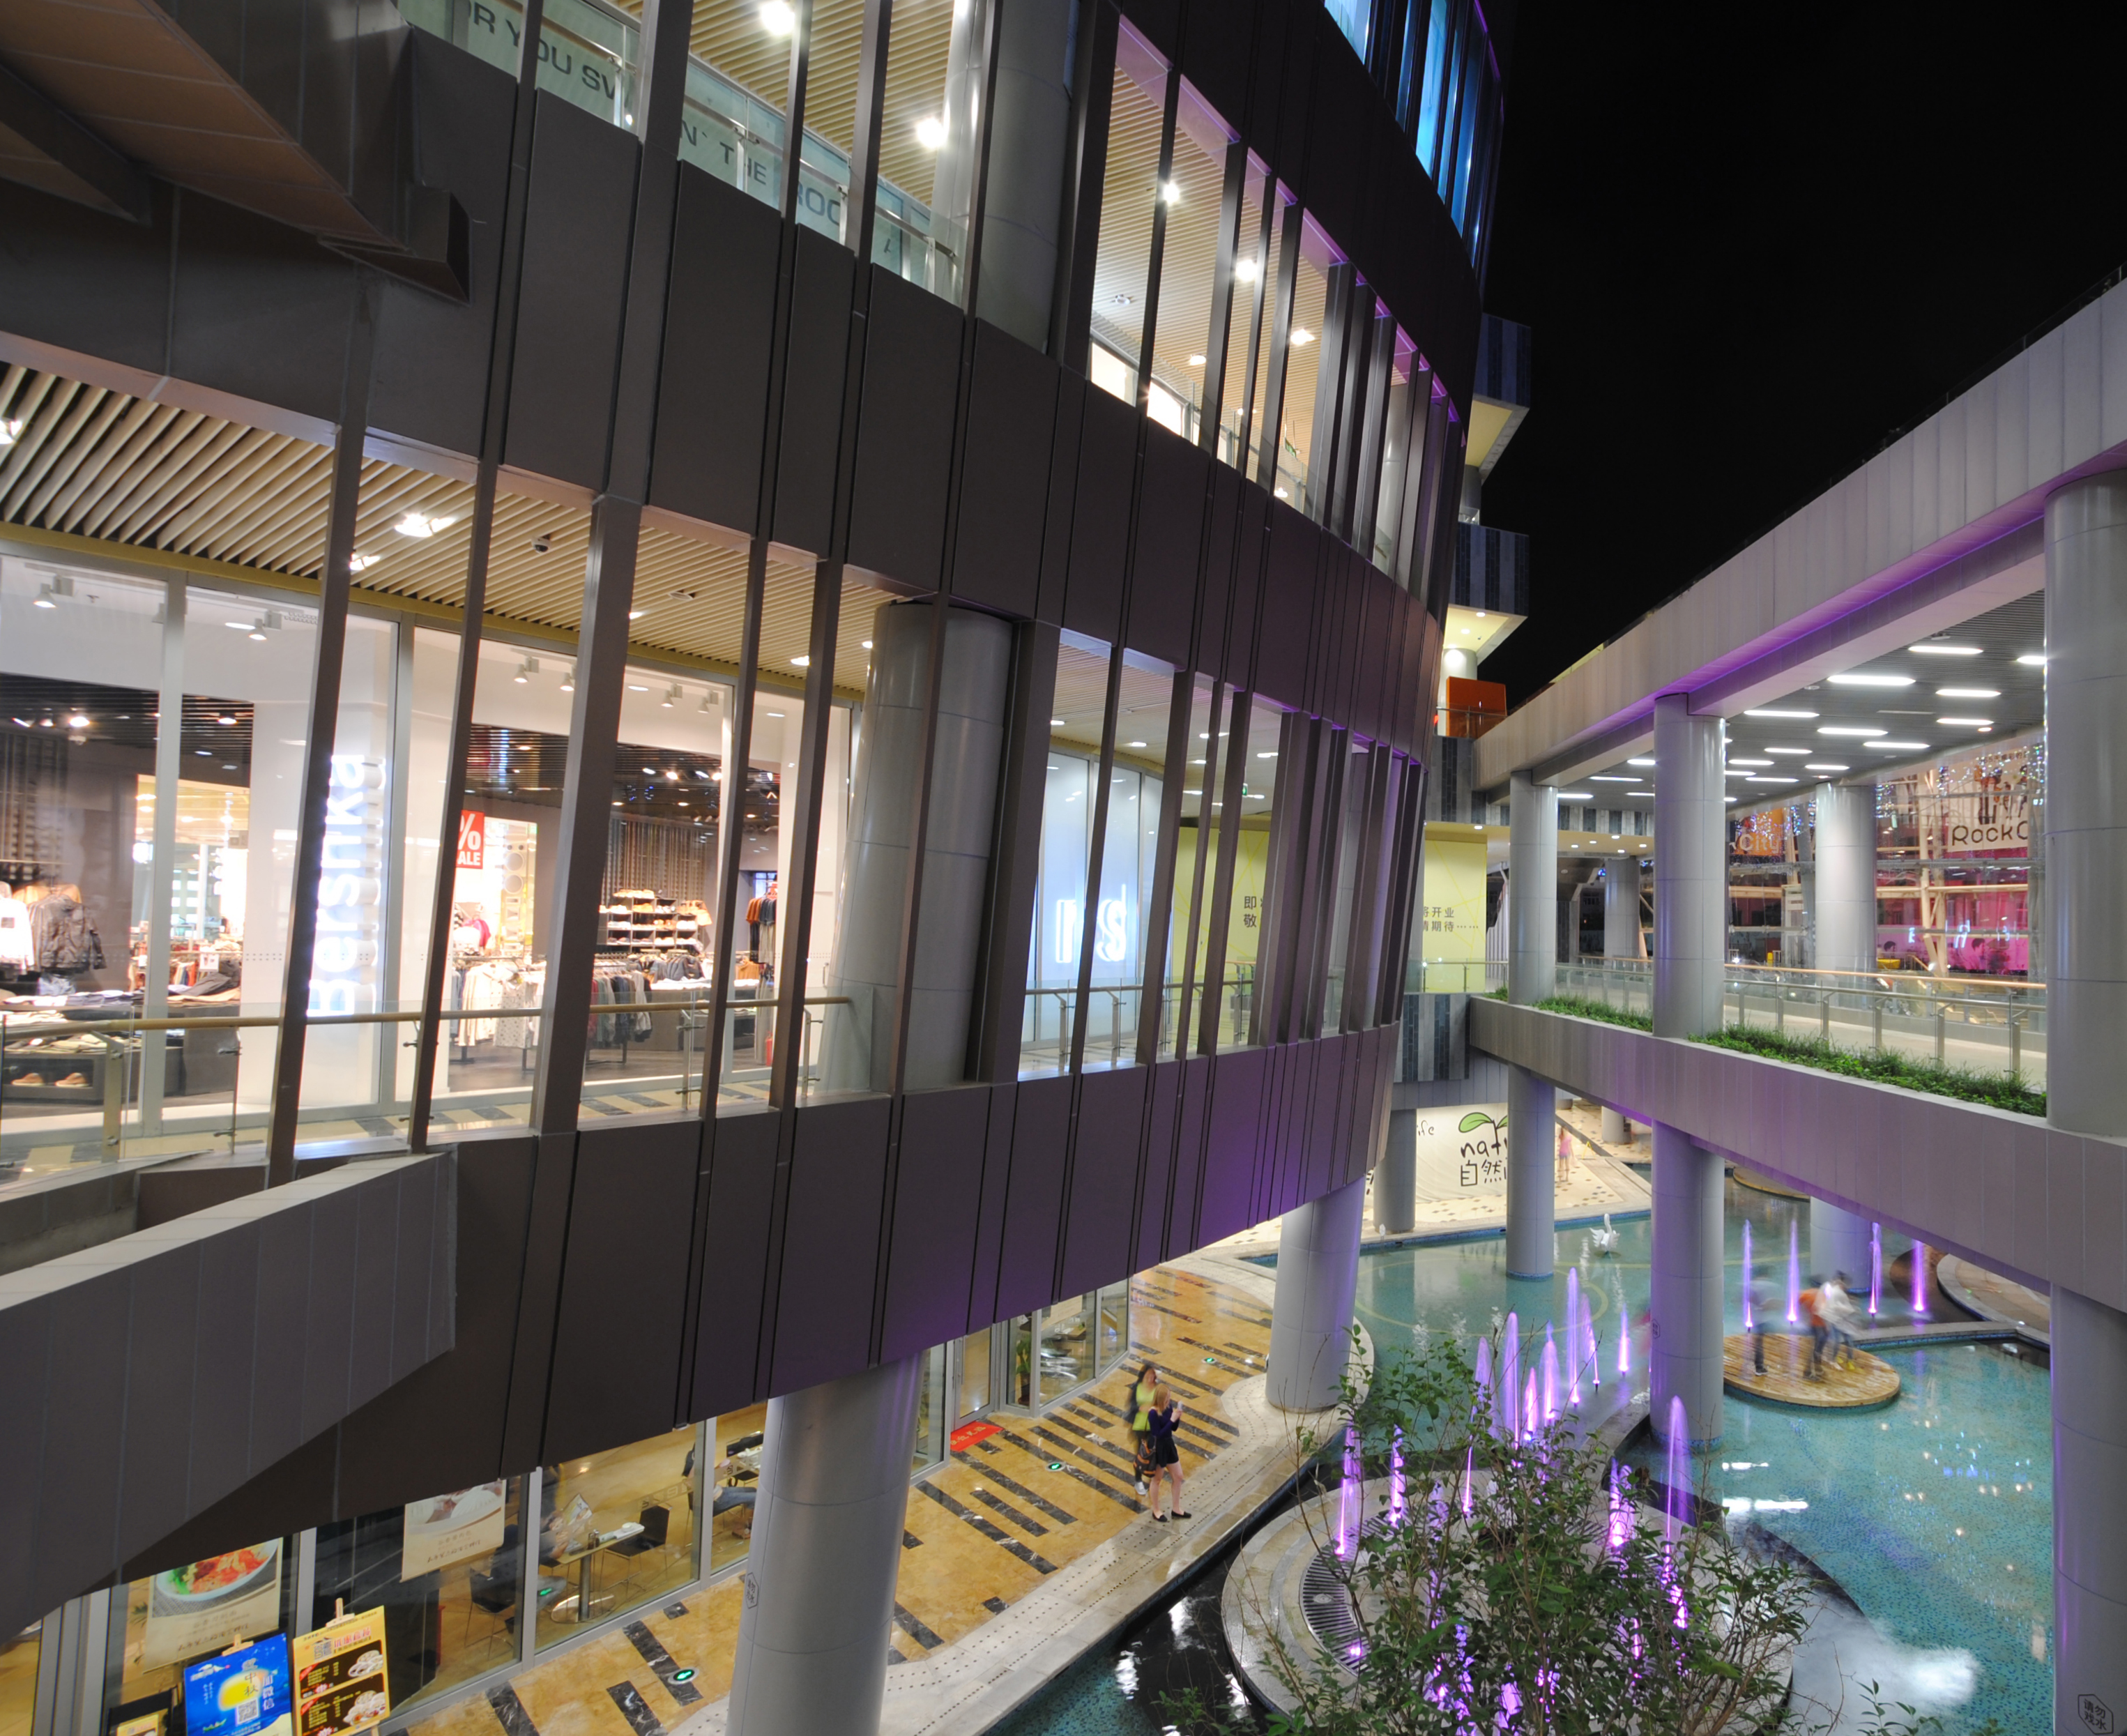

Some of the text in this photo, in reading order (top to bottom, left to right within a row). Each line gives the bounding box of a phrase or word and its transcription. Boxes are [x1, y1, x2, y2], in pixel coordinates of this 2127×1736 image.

[1730, 833, 1781, 854] City
[306, 754, 384, 1017] Bershka
[1244, 895, 1263, 911] 即
[1243, 913, 1257, 928] 敬
[1460, 1128, 1507, 1158] nat
[1461, 1159, 1507, 1187] 自然
